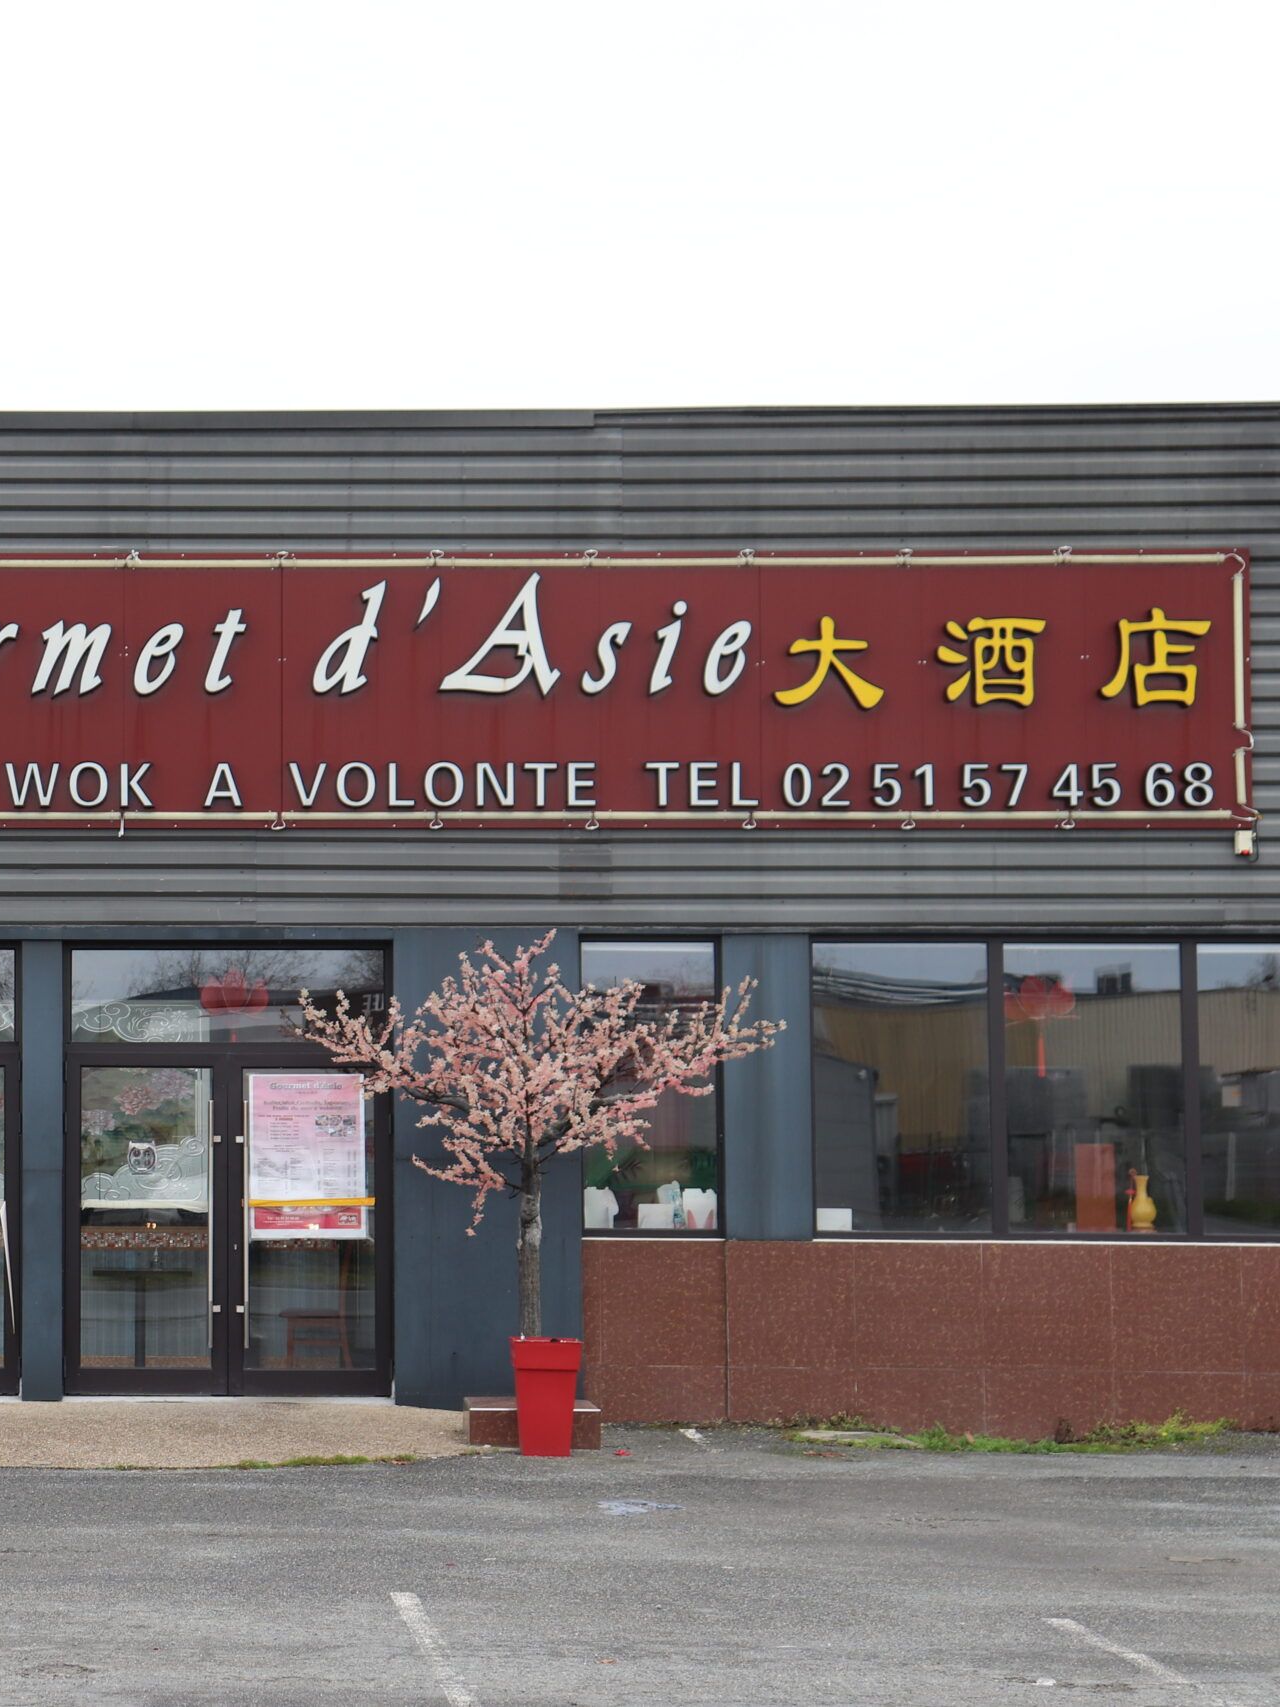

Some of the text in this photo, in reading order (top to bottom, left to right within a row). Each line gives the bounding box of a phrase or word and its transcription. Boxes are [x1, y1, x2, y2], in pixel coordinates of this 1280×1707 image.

[312, 572, 753, 696] d'Asie
[774, 606, 1213, 708] 大酒店
[4, 762, 153, 806] WOK
[203, 762, 243, 806] A
[288, 762, 597, 806] VOLONTE
[645, 762, 760, 806] TEL
[782, 762, 850, 806] 02
[873, 762, 934, 806] 51
[962, 762, 1029, 806] 57
[1052, 762, 1122, 806] 45
[1144, 762, 1215, 806] 68
